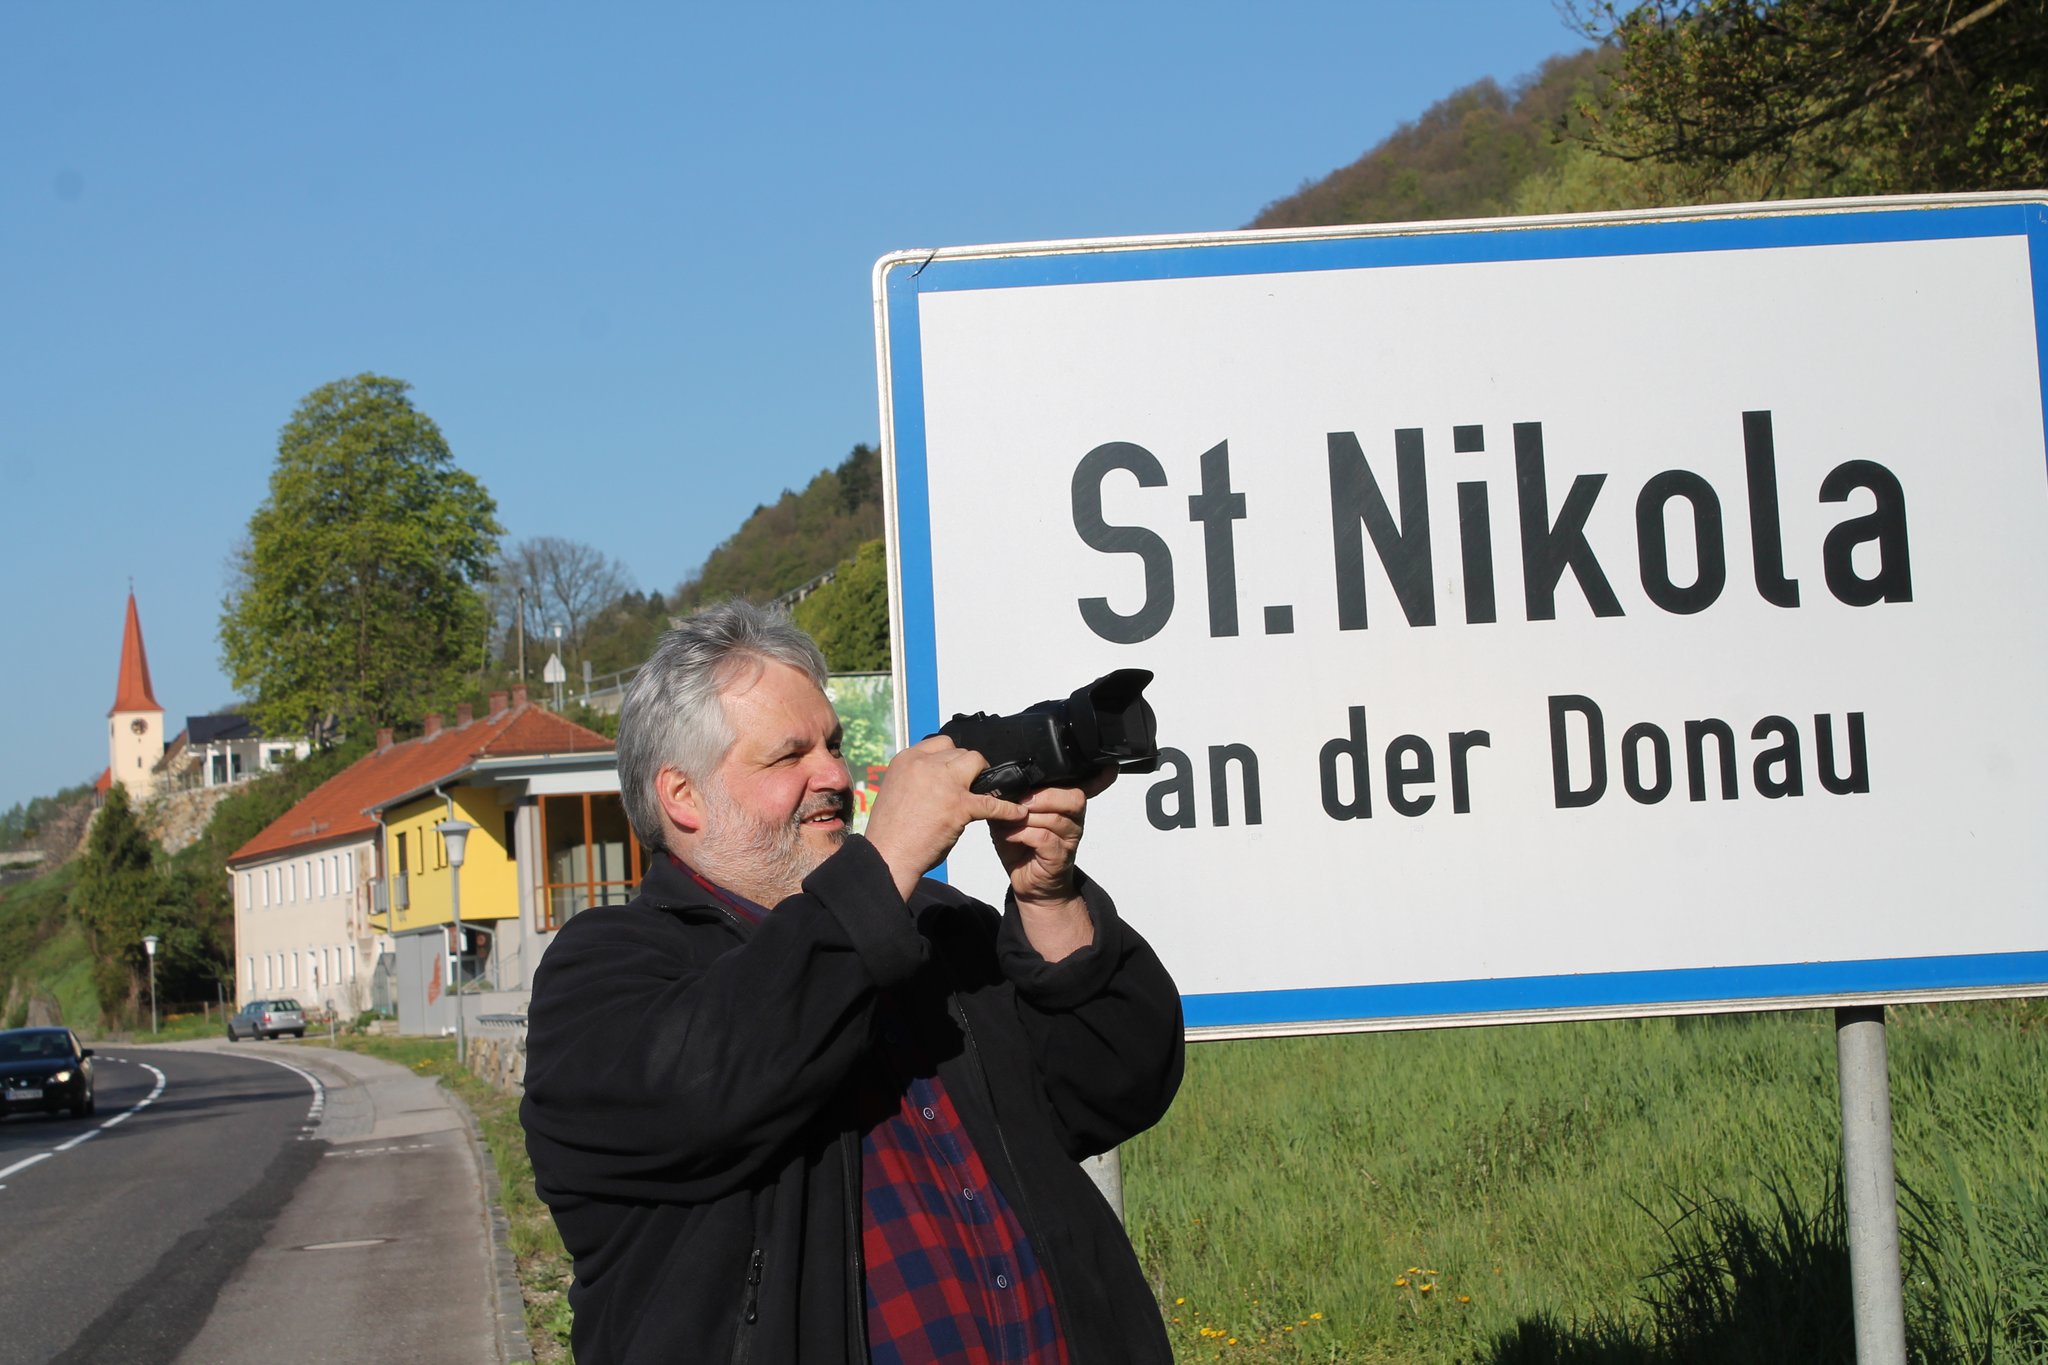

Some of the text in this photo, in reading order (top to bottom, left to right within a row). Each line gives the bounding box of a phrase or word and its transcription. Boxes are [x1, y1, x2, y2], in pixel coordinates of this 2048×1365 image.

[1145, 694, 1870, 831] an der Donau
